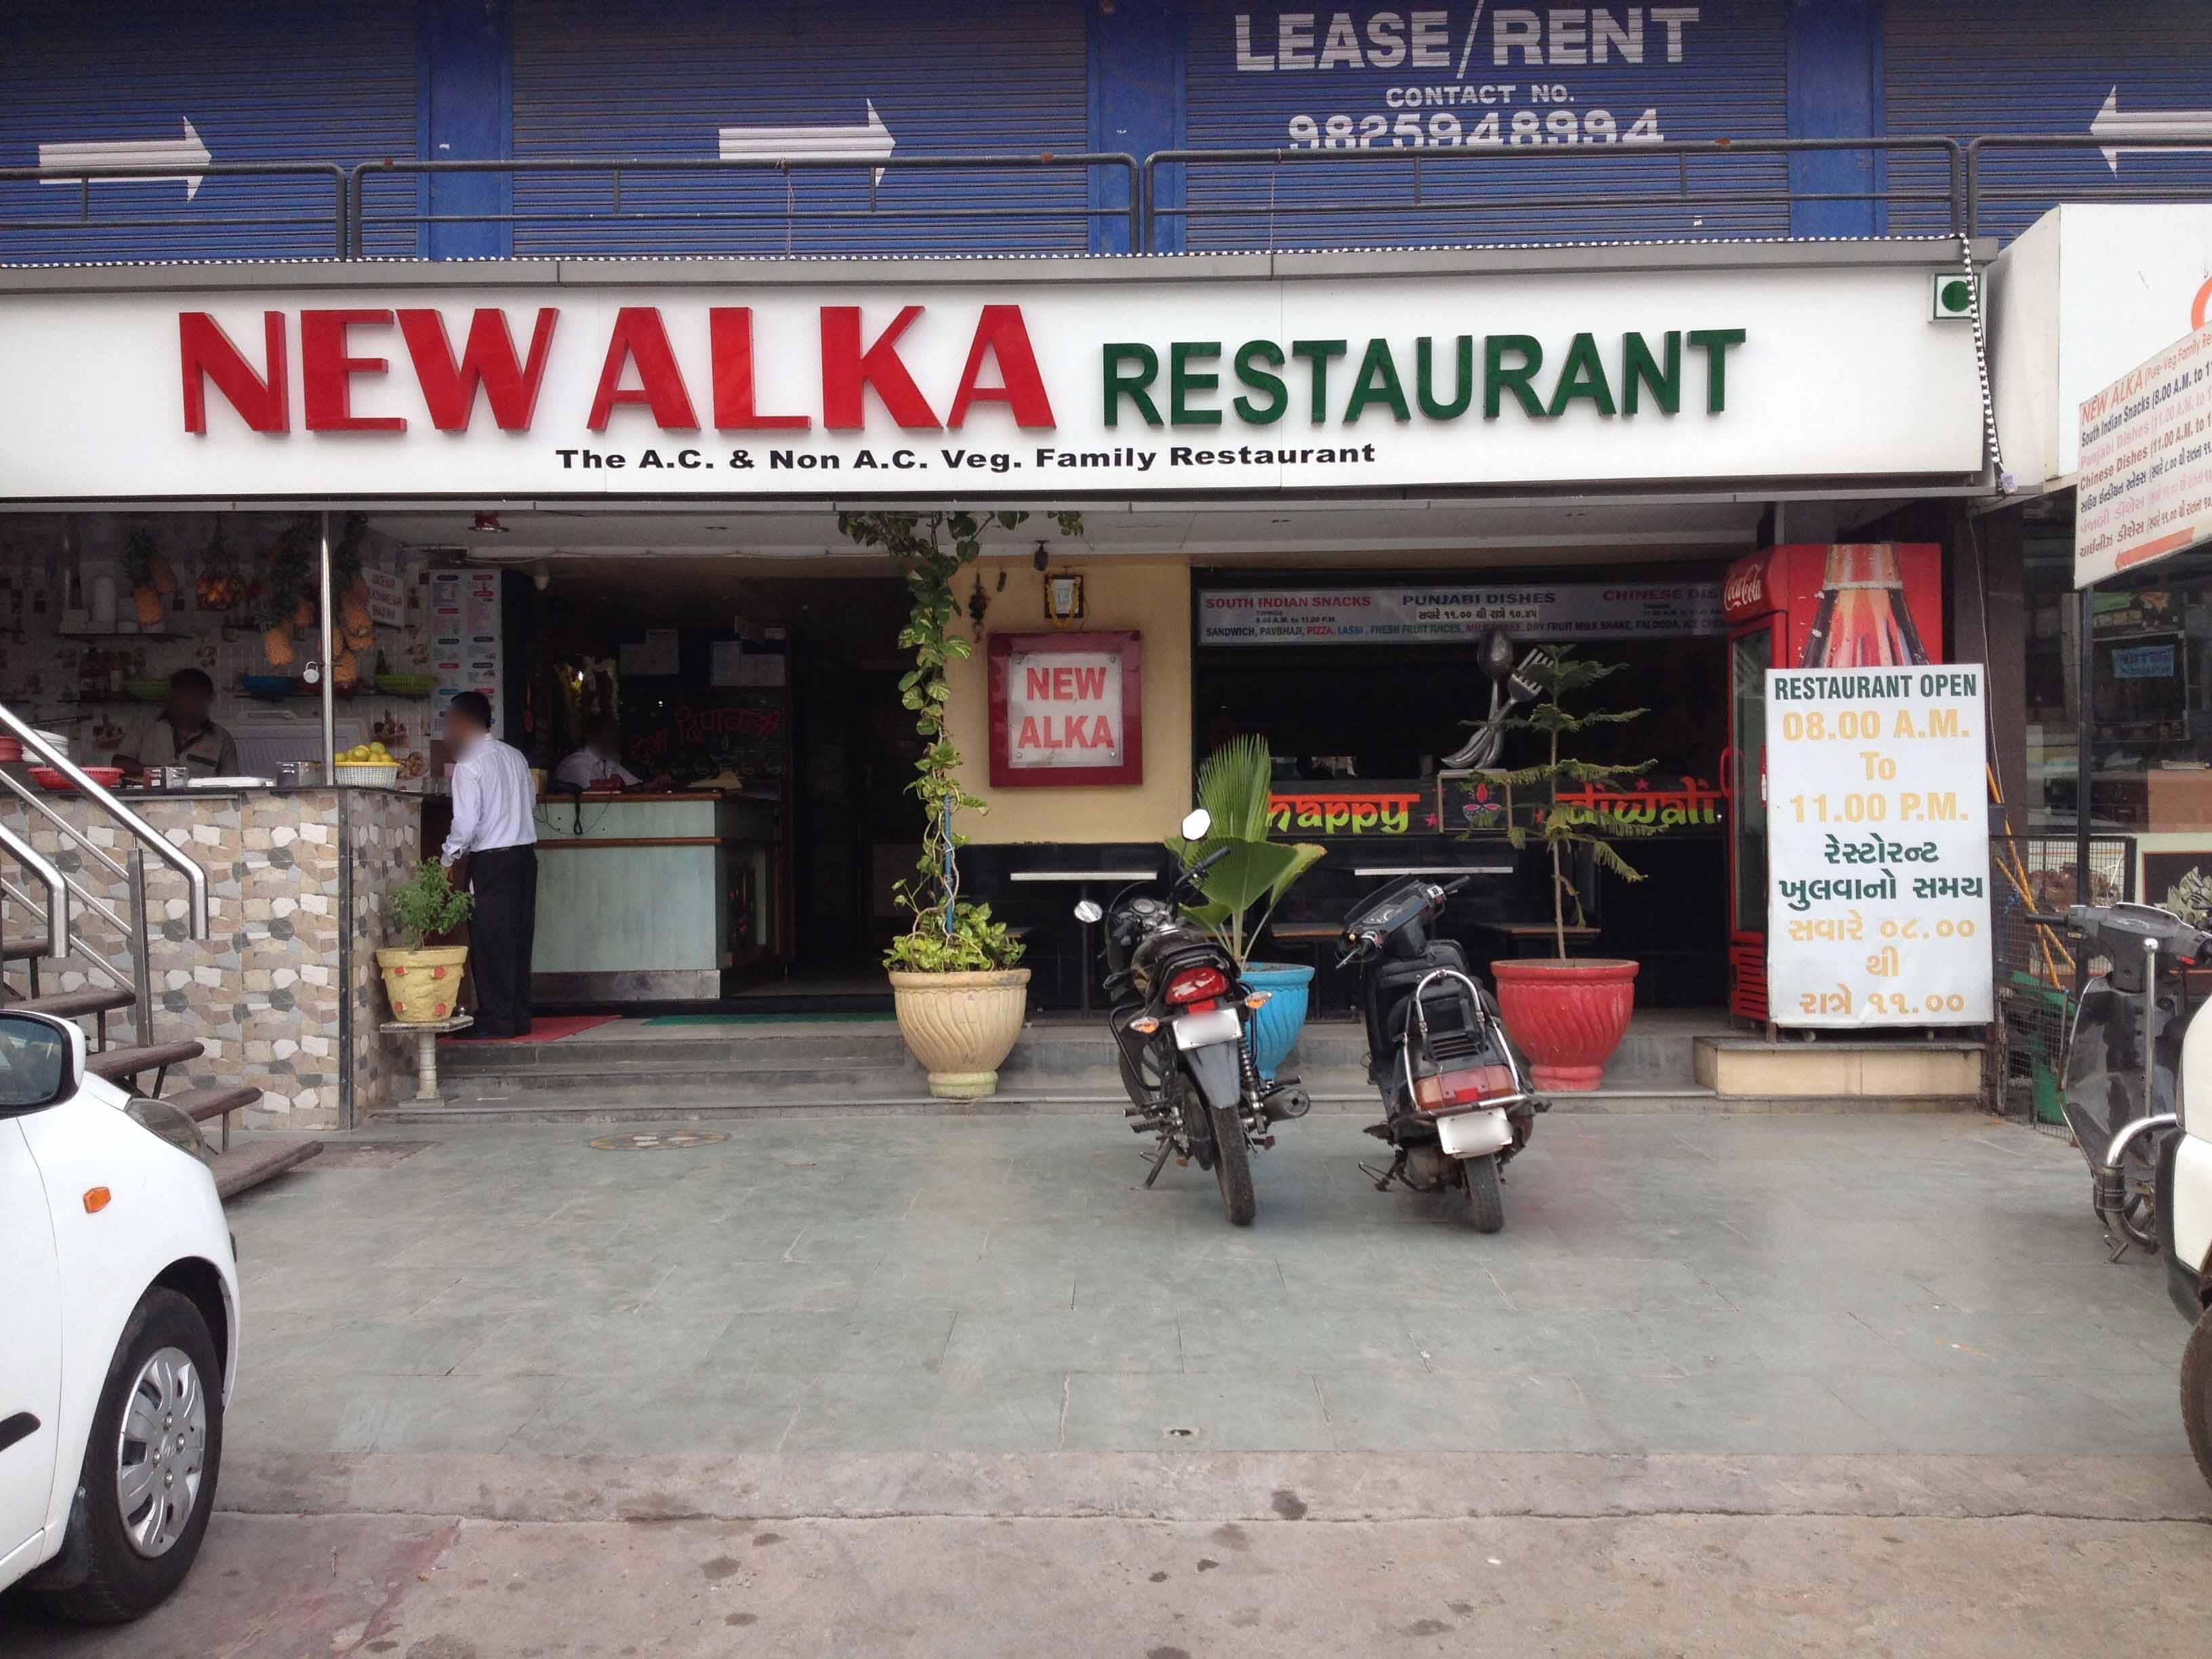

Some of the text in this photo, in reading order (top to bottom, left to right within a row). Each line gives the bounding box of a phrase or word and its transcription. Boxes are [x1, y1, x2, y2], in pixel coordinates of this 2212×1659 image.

[1235, 0, 1700, 79] LEASE/RENT
[1385, 83, 1576, 108] CONTACT NO.
[178, 304, 1747, 435] NEW ALKA RESTAURANT
[2081, 392, 2109, 424] NEW
[2111, 370, 2144, 407] ALKA
[2081, 424, 2100, 448] South
[2101, 413, 2123, 437] Indian
[2124, 395, 2150, 423] Snacks
[2173, 372, 2192, 396] A.M.
[2194, 368, 2203, 384] to
[556, 443, 1376, 474] The A.C. & Non A.C. Veg. Family Restaurant
[2080, 465, 2114, 491] Chinese
[2116, 446, 2148, 472] Dishes
[2175, 420, 2193, 443] A.M.
[2196, 417, 2205, 433] to
[2081, 439, 2114, 470] Punjabi
[2116, 422, 2150, 449] Dishes
[1205, 595, 1371, 609] SOUTH INDIAN SNACKS
[1402, 592, 1556, 606] PUNJABI DISHES
[1603, 589, 1681, 602] CHINESE
[1206, 627, 1258, 638] SANDWICH,
[1370, 625, 1400, 634] FRESH
[1026, 666, 1107, 701] NEW
[1774, 674, 1977, 700] RESTAURANT OPEN
[1017, 715, 1115, 749] ALKA
[1782, 709, 1970, 741] 08.00 A.M.
[1860, 751, 1897, 781] To
[1790, 792, 1969, 823] 11.00 P.M.
[1824, 833, 1940, 864] રેસ્ટોરન્ટ
[1779, 868, 1984, 912] ખુલવાનો સમય
[1788, 909, 1976, 941] સવારે ૦૮.૦૦
[1865, 945, 1900, 977] થી
[1799, 983, 1965, 1015] રાત્રે ૧૧.૦૦
